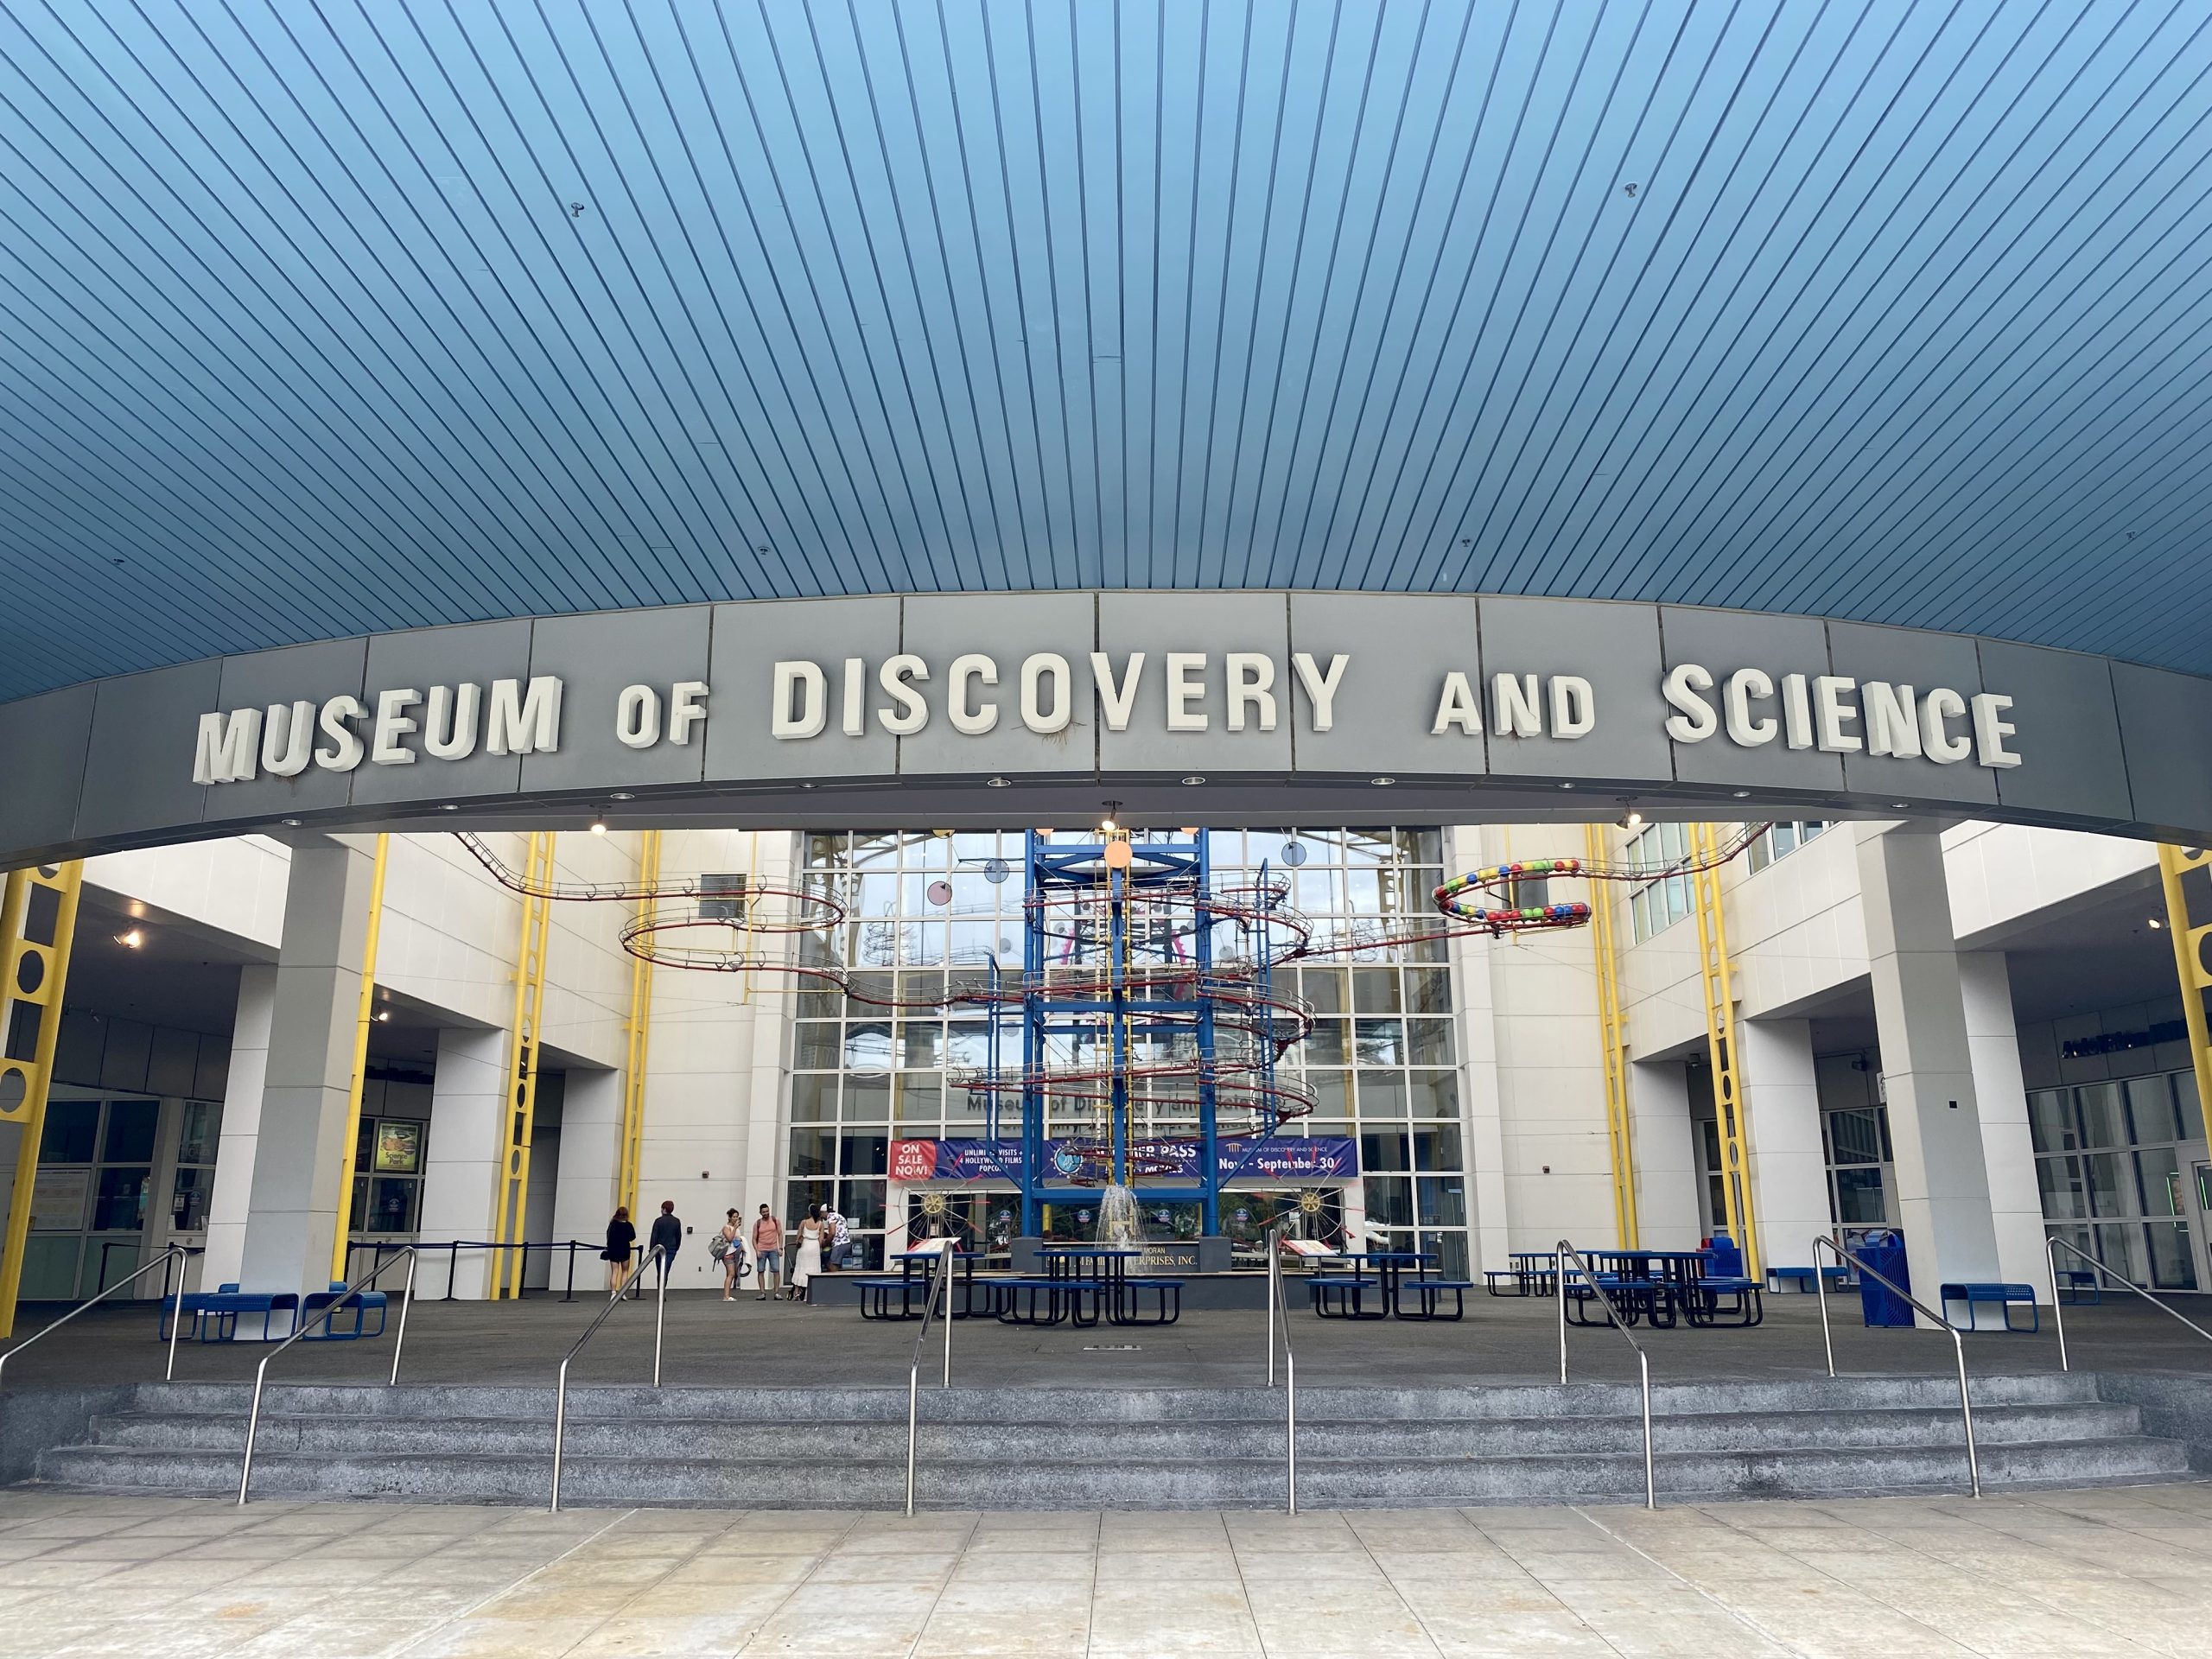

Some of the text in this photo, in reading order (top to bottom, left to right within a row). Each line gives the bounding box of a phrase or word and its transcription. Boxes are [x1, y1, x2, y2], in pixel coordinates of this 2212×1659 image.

[193, 652, 2022, 785] MUSEUM OF DISCOVERY AND SCIENCE
[901, 1144, 919, 1154] ON
[1160, 1145, 1197, 1158] PASS
[898, 1154, 923, 1165] SALE
[1256, 1157, 1315, 1173] September
[1319, 1157, 1335, 1169] 30
[895, 1166, 928, 1176] NOW!
[1178, 1255, 1198, 1266] INC.
